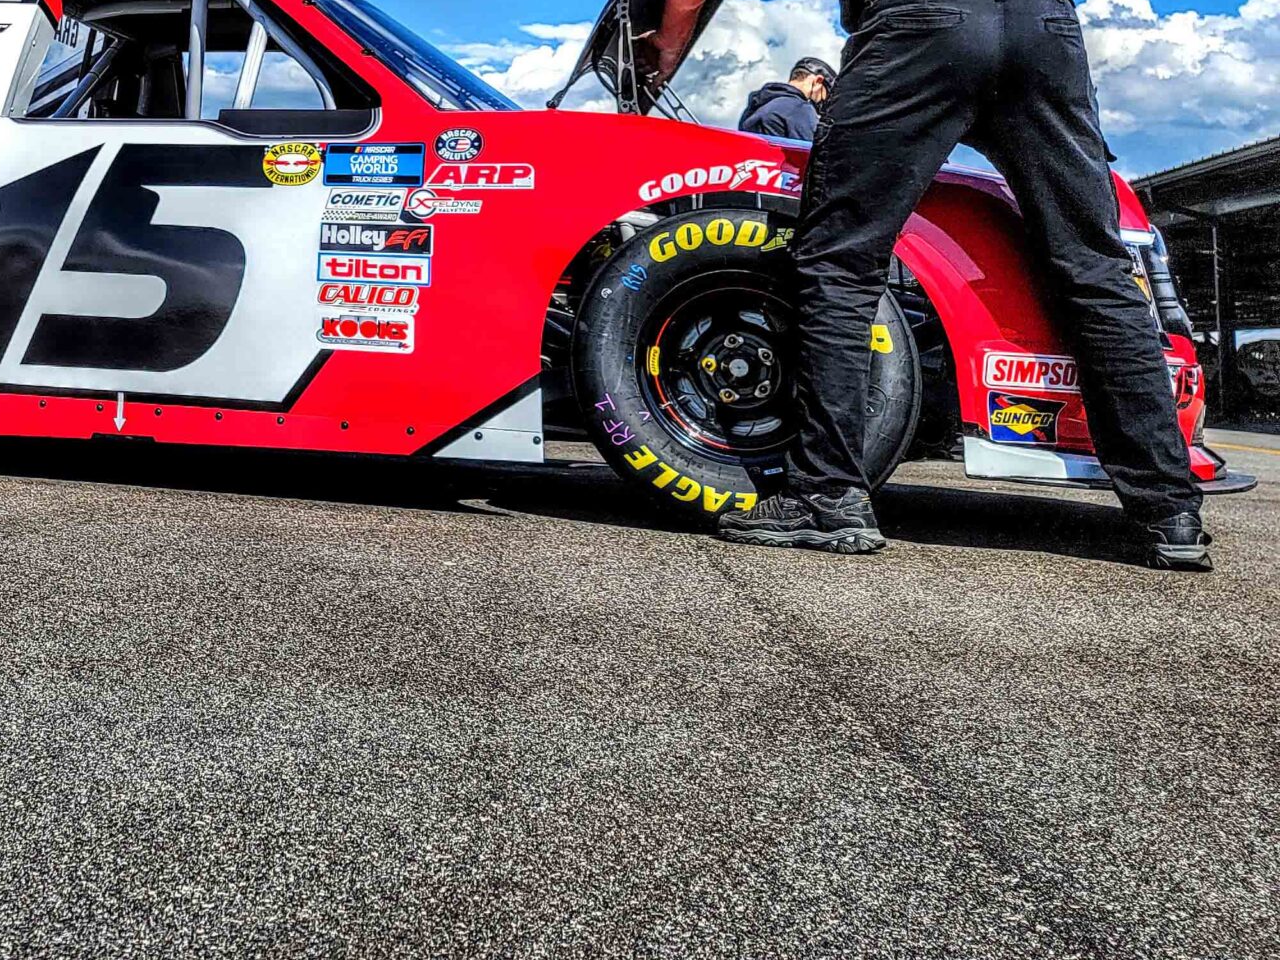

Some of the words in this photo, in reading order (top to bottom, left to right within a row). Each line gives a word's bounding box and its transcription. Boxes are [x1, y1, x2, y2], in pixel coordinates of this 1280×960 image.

[440, 129, 478, 141] NASCAR
[271, 144, 315, 157] NASCAR
[438, 147, 478, 160] SALUTES
[350, 155, 398, 164] CAMPING
[265, 167, 317, 184] INTERNATIONAL
[350, 163, 398, 174] WORLD
[428, 165, 532, 185] ARP
[638, 161, 803, 201] GOODYE
[330, 192, 401, 206] COMETIC
[321, 225, 385, 251] Holley
[325, 257, 422, 280] tilton
[320, 284, 415, 305] CALICO
[368, 306, 415, 314] COATINGS
[322, 317, 409, 341] KOOKS
[993, 359, 1077, 386] SIMPSO
[993, 412, 1052, 426] SUNOCO
[624, 445, 758, 512] EAGLE
